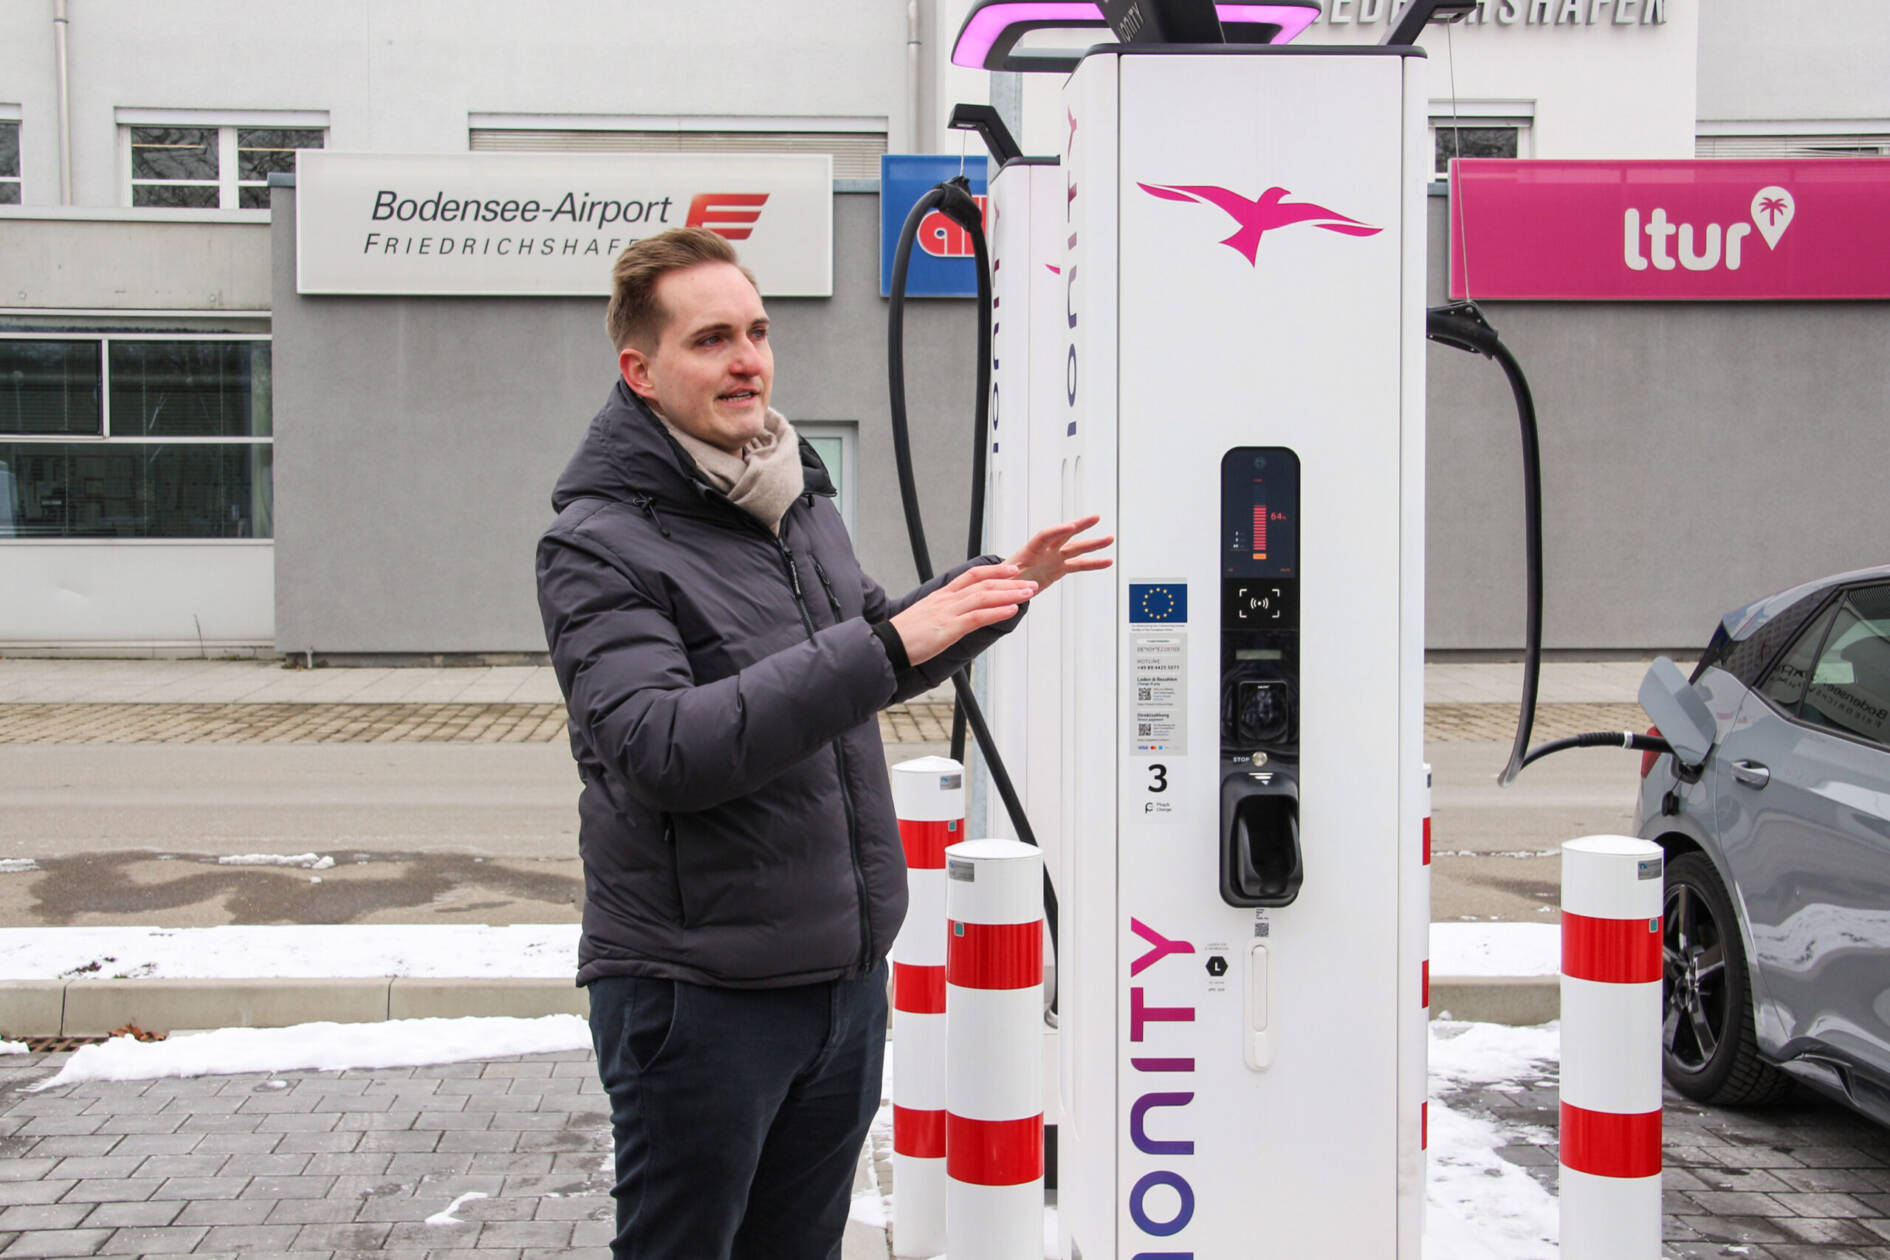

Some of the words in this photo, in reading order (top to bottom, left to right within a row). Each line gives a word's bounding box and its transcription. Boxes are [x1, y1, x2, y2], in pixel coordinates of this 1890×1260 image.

[371, 189, 672, 229] Bodensee-Airport
[1624, 208, 1752, 271] ltur
[1148, 763, 1168, 794] 3
[1214, 961, 1221, 971] L
